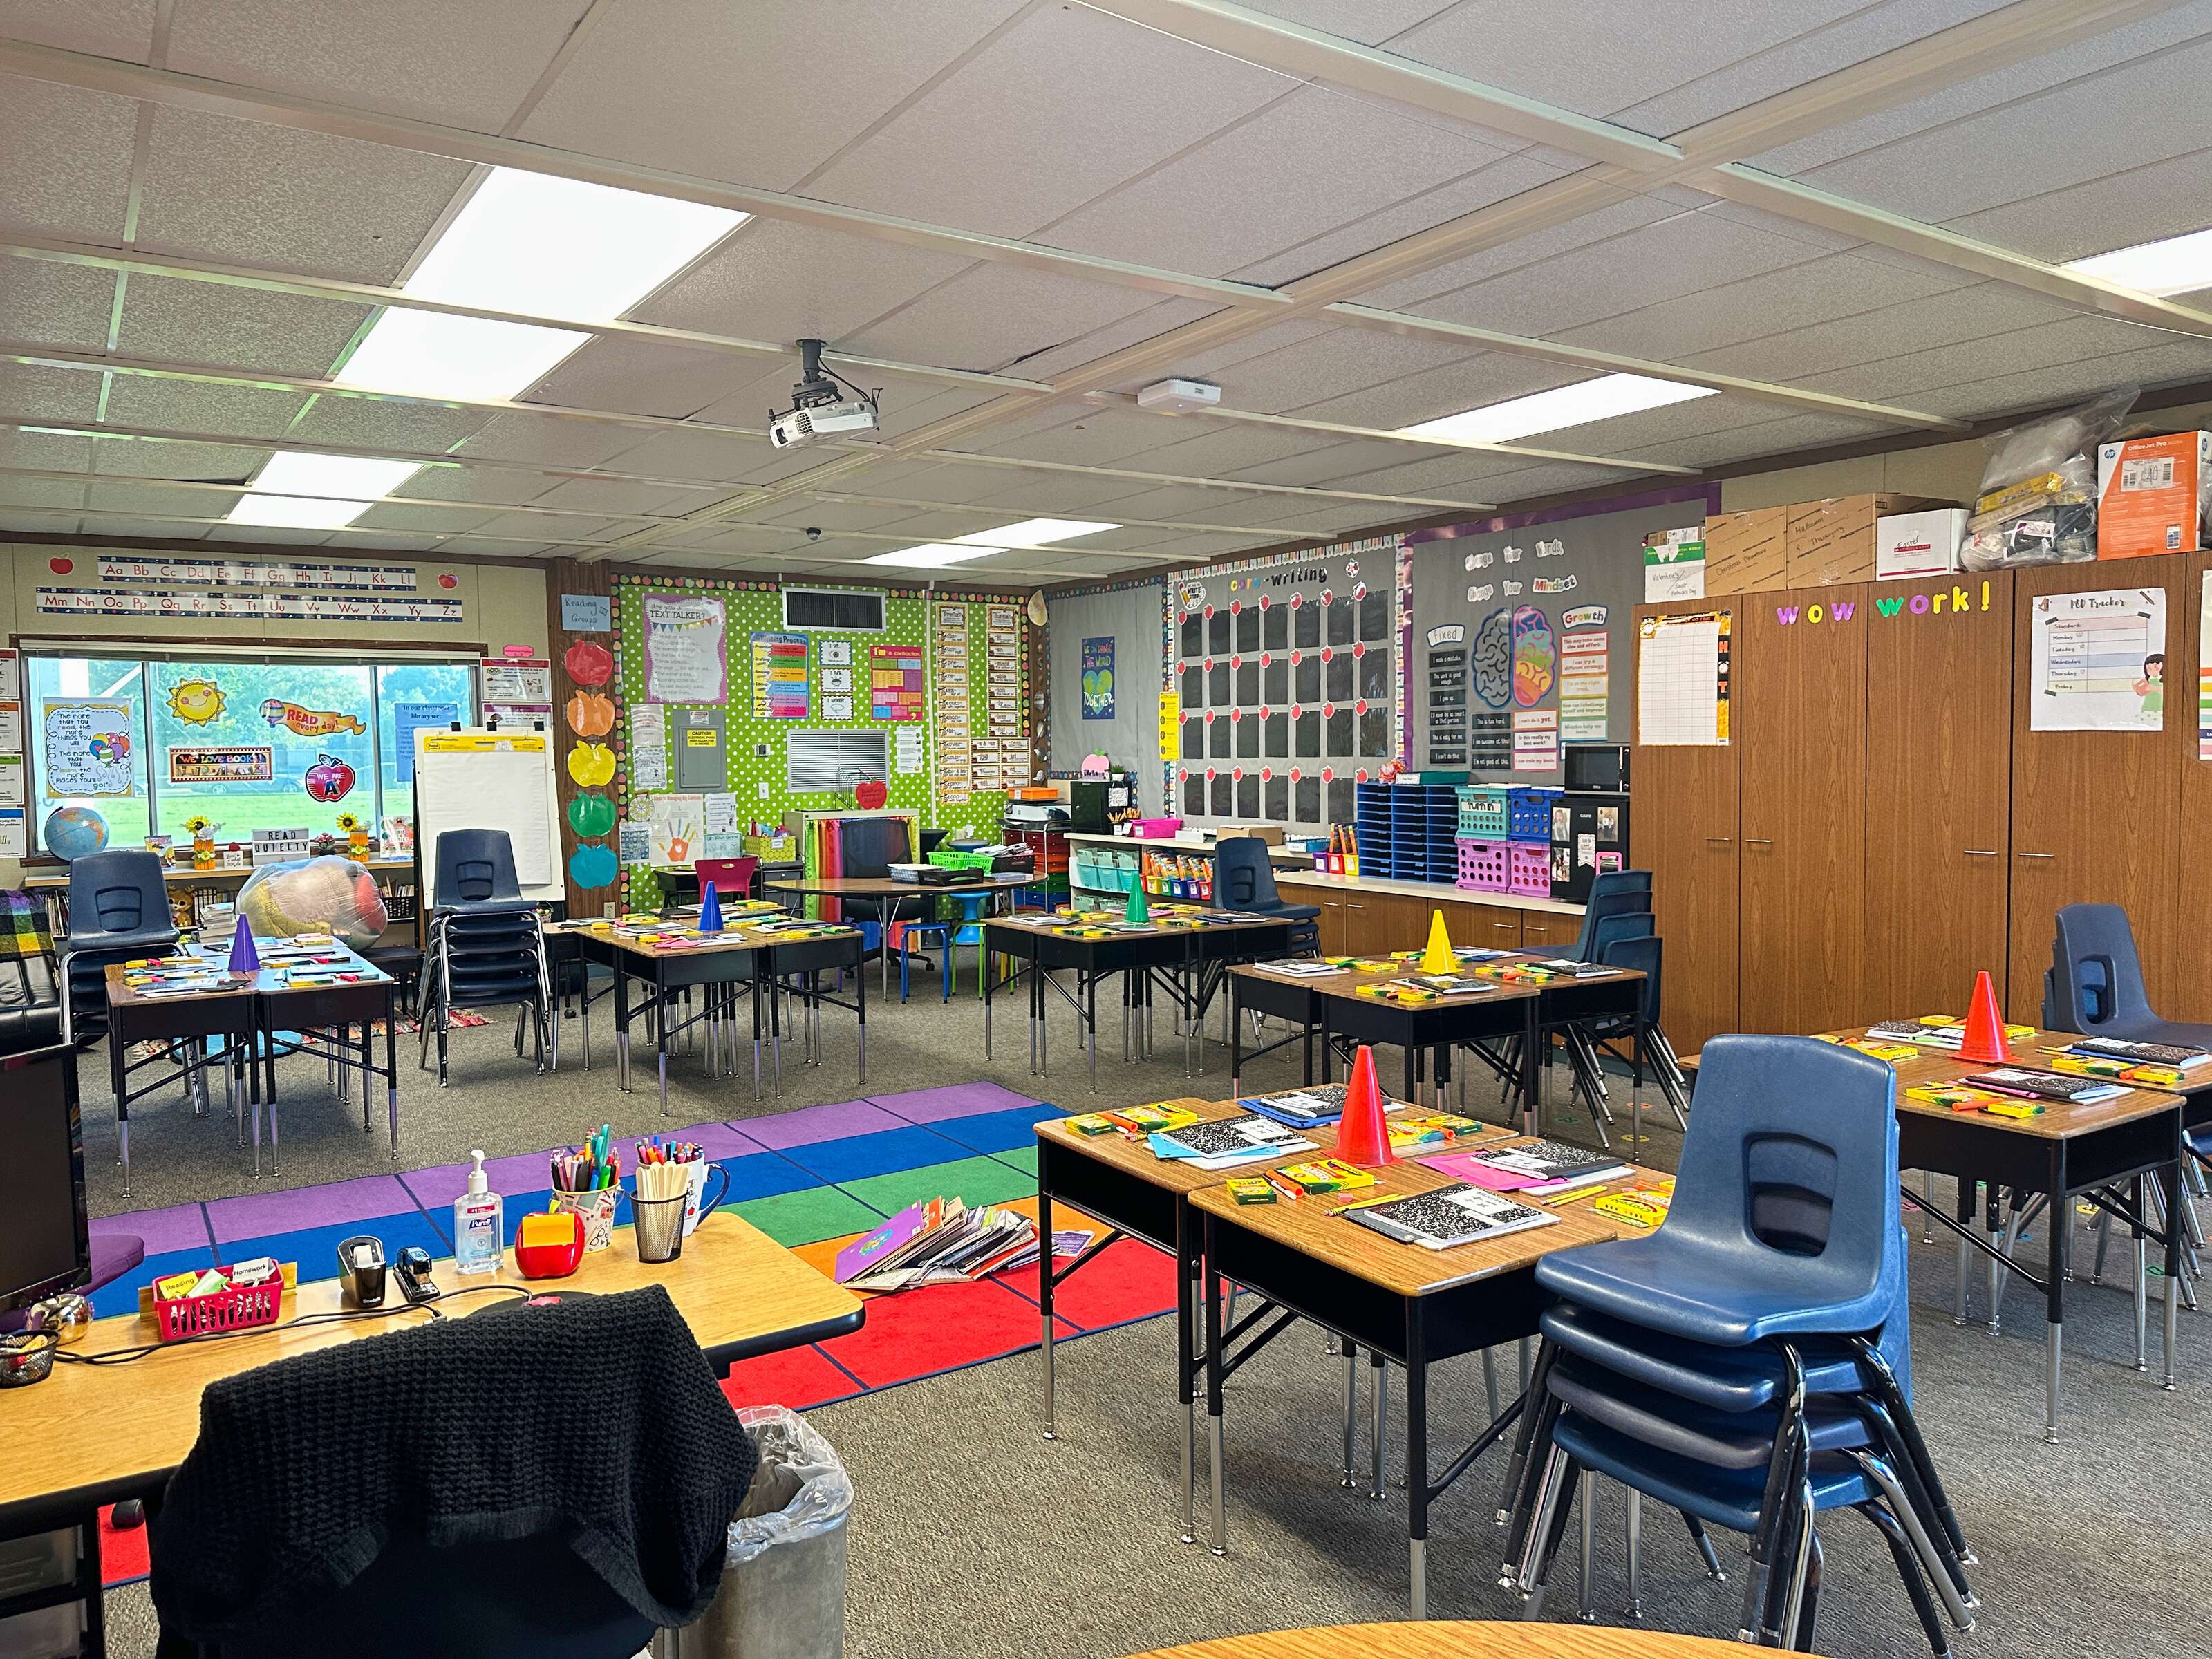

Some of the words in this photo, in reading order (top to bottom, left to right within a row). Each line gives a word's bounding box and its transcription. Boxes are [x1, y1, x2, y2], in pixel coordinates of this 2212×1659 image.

[2106, 450, 2115, 458] hp
[1897, 536, 1920, 547] Easter
[1504, 547, 1521, 561] Your
[105, 564, 123, 575] Aa
[133, 565, 149, 575] Bb
[160, 565, 176, 577] Cc
[188, 567, 204, 578] Dd
[218, 568, 231, 578] Ee
[244, 569, 254, 579] Ff
[268, 570, 285, 583] Gg
[296, 571, 310, 581] Hh
[323, 572, 332, 582] Ii
[347, 572, 357, 584] Jj
[372, 574, 386, 583] Kk
[401, 574, 410, 584] Ll
[1469, 586, 1492, 600] Change
[1504, 581, 1521, 595] Your
[1535, 576, 1575, 591] Mindset
[1875, 581, 1989, 617] work!
[2089, 597, 2125, 608] Tracker
[45, 596, 67, 606] Mm
[77, 597, 95, 607] Nn
[104, 597, 123, 608] Oo
[133, 598, 147, 610] Pp
[161, 599, 180, 611] Qq
[193, 599, 205, 609] Rr
[220, 600, 233, 610] Ss
[246, 601, 256, 611] Tt
[270, 601, 285, 612] Uu
[307, 602, 320, 612] Vv
[338, 603, 359, 613] Ww
[373, 605, 388, 615] Xx
[408, 606, 421, 617] Yy
[443, 606, 457, 616] Zz
[565, 597, 597, 615] Reading
[572, 614, 597, 627] Groups
[671, 611, 705, 619] TALKER?
[1565, 610, 1604, 624] Growth
[782, 636, 805, 644] Process
[1434, 629, 1457, 641] Fixed
[874, 647, 885, 655] I'm
[287, 709, 318, 725] READ
[296, 722, 319, 733] every
[321, 720, 339, 730] day!
[180, 754, 196, 763] WE
[200, 754, 224, 764] LOVE
[268, 832, 297, 841] READ
[254, 842, 308, 852] QUIELTY
[1611, 1198, 1651, 1212] Crayola
[471, 1219, 491, 1227] Purell
[234, 1264, 267, 1277] Homework
[166, 1277, 195, 1291] Reading
[362, 1296, 382, 1304] Scotch
